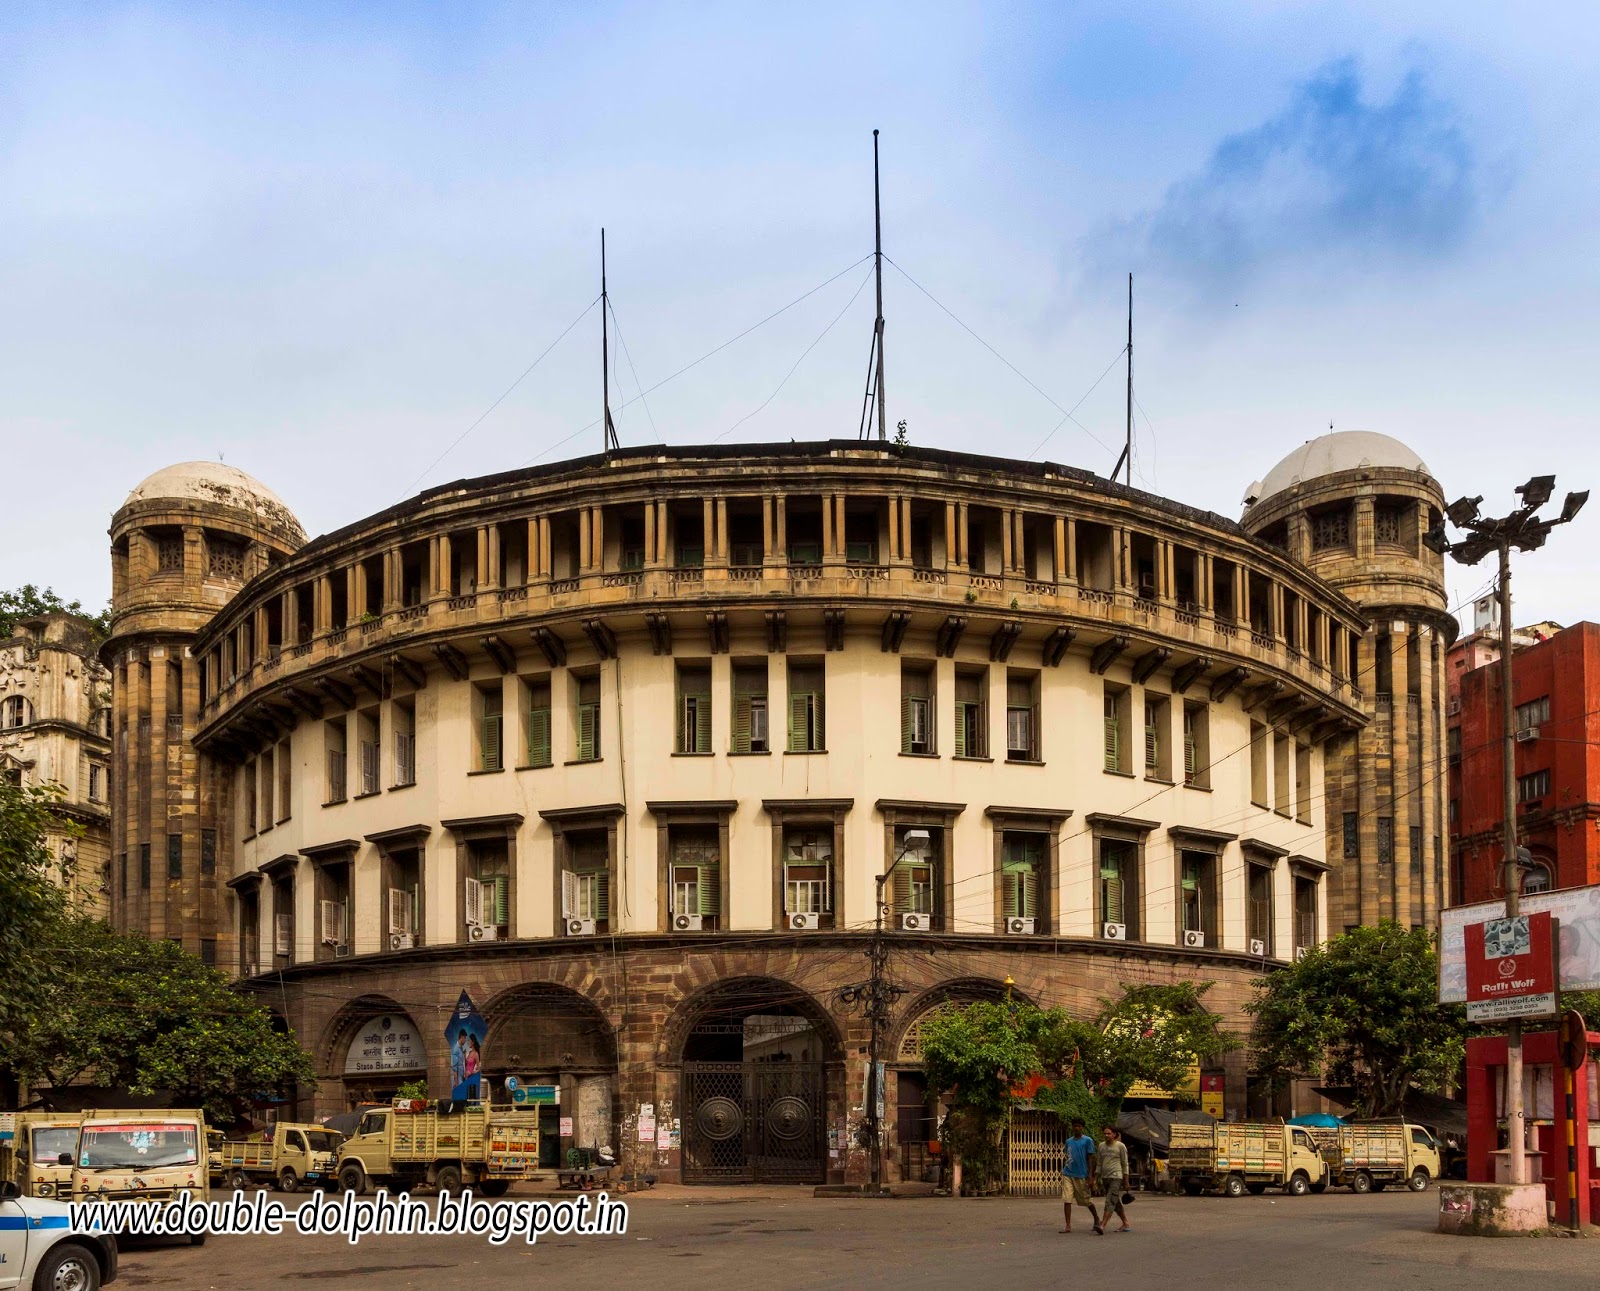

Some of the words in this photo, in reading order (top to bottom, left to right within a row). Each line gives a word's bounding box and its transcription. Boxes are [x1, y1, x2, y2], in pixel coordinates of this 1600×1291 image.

[1481, 982, 1508, 993] Ralli
[1510, 978, 1536, 989] Wolf
[1471, 995, 1549, 1009] www.ralliwolf.com
[363, 1046, 382, 1057] भारतीय
[384, 1046, 397, 1056] स्टेट
[356, 1062, 374, 1071] State
[375, 1061, 392, 1070] Bank
[393, 1060, 401, 1068] of
[402, 1059, 419, 1068] India
